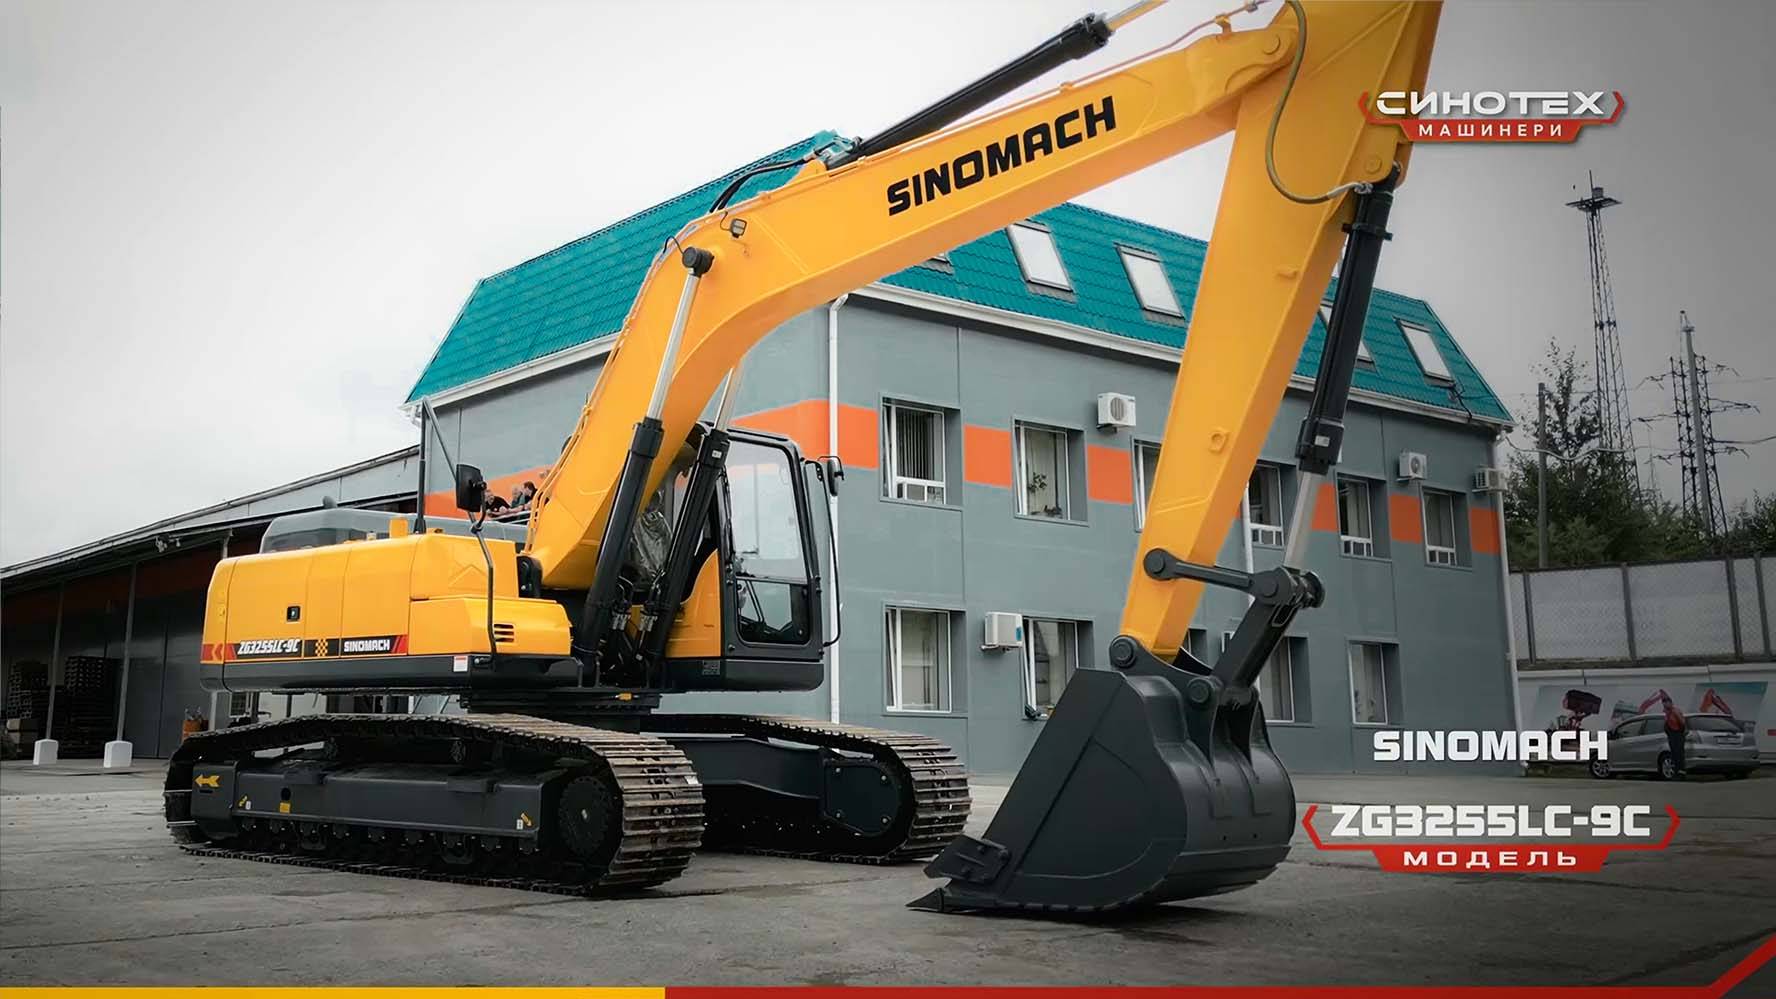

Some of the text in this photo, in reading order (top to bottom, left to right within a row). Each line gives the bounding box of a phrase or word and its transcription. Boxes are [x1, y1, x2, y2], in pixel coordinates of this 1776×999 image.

[887, 96, 1116, 216] SINOMACH
[237, 639, 300, 655] ZG3255LC-9C
[344, 639, 390, 652] SINOMACH
